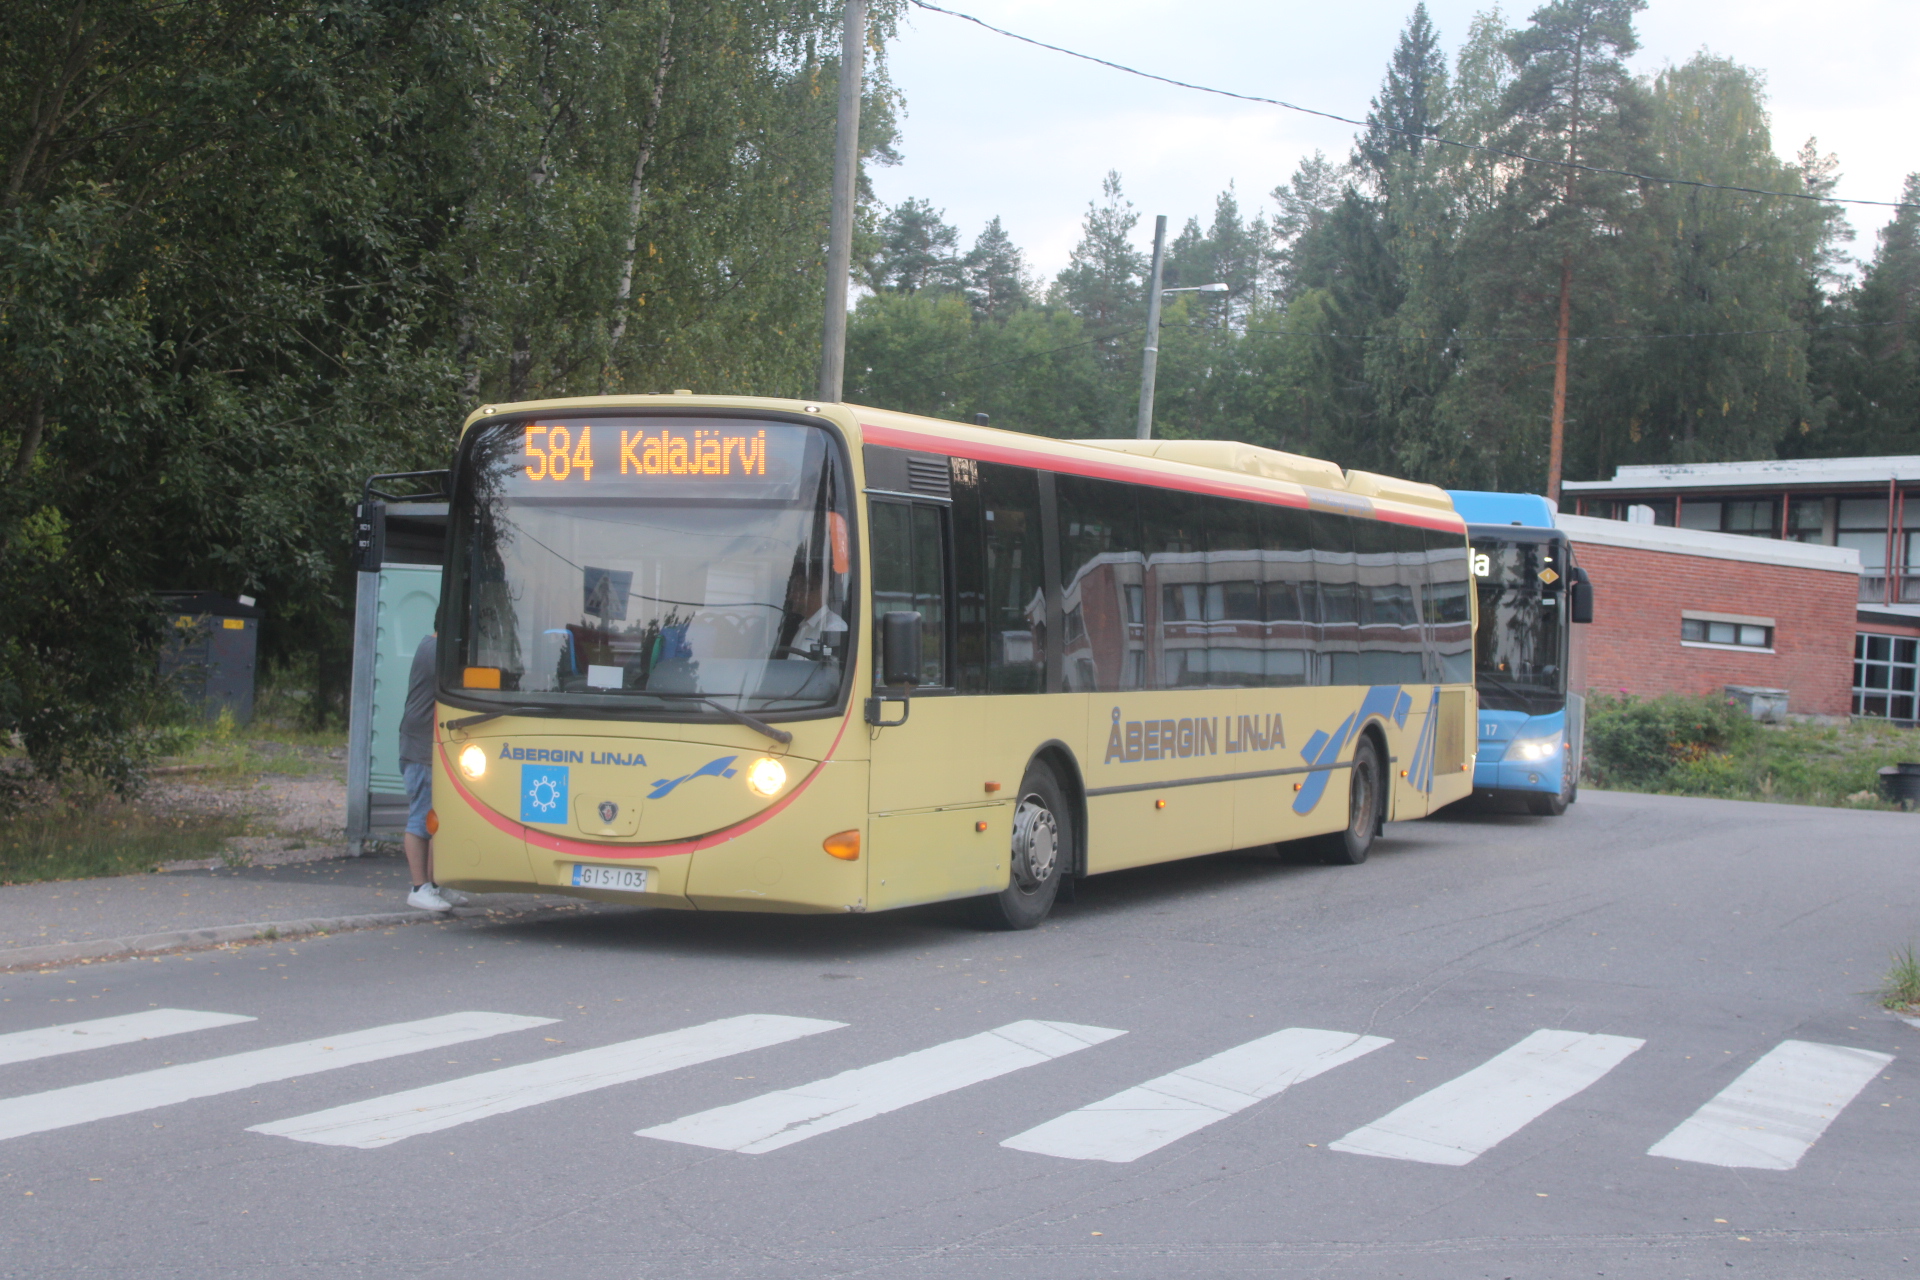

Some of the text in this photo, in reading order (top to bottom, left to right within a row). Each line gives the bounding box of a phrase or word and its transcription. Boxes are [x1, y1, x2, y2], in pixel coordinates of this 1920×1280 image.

[525, 426, 765, 480] 584 Kalajärvi
[499, 742, 648, 767] ÅBERGIN LINJA
[1104, 706, 1286, 765] ÅBERGIN LINJA
